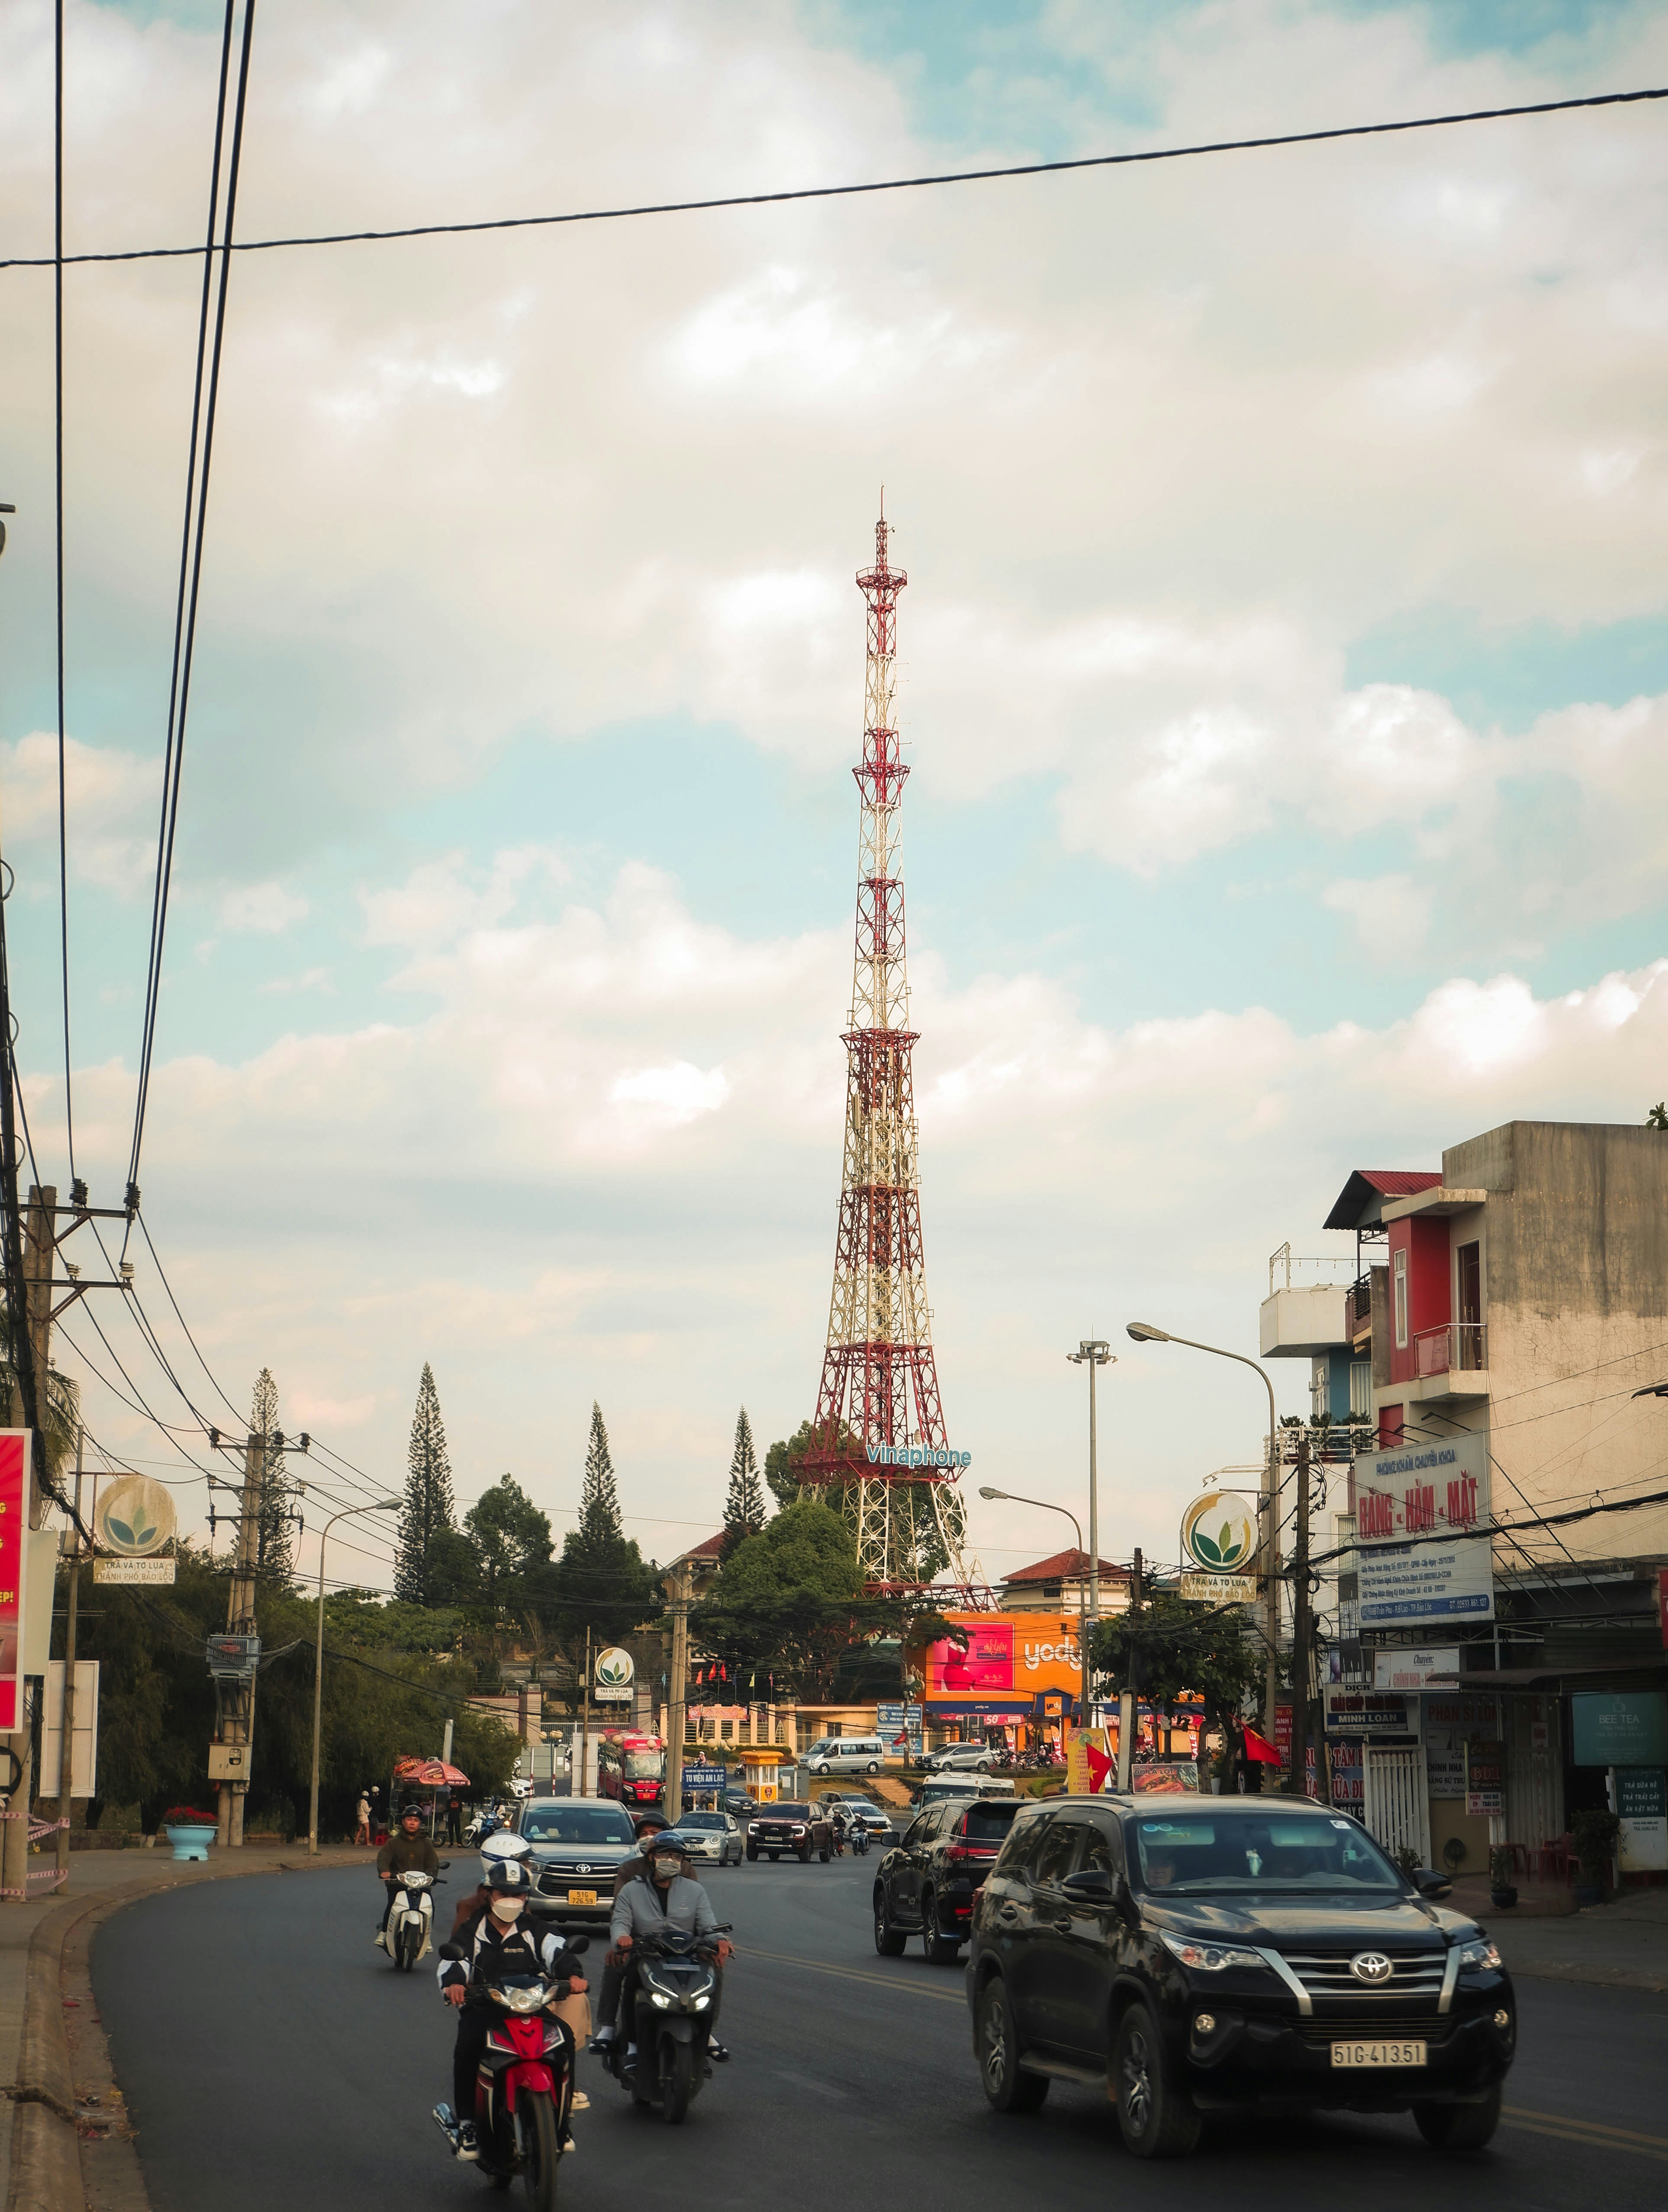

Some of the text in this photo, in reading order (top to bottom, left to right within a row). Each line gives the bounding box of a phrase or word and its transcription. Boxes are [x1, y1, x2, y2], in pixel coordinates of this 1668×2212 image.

[866, 1441, 971, 1469] vinaphone
[1405, 1478, 1436, 1533] HÀM
[1447, 1469, 1478, 1532] MẶT
[1047, 1701, 1061, 1710] yody
[1338, 1714, 1397, 1723] MINH LOAN
[1599, 1714, 1640, 1724] BEE TEA
[1333, 1741, 1356, 1768] TÂM
[693, 1772, 705, 1784] VIỆN
[705, 1774, 713, 1782] AN
[1470, 1765, 1503, 1780] 601
